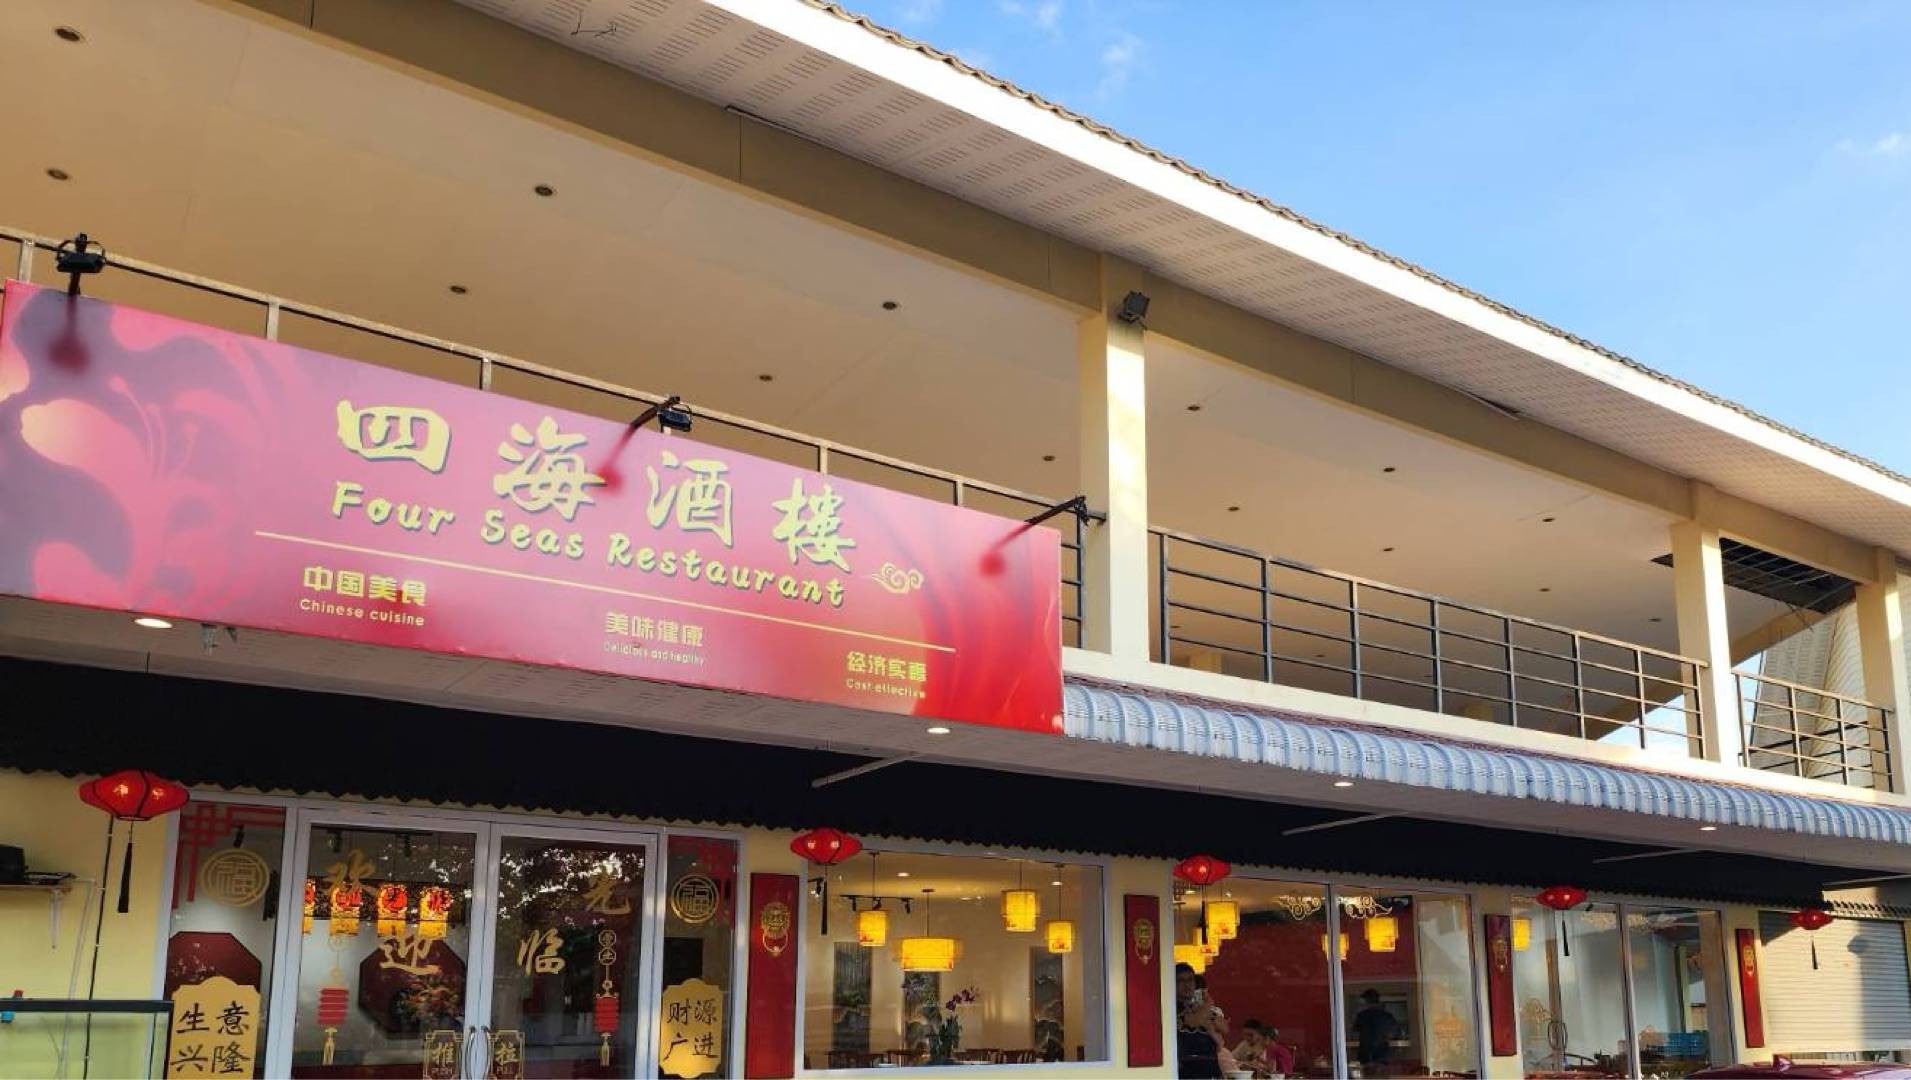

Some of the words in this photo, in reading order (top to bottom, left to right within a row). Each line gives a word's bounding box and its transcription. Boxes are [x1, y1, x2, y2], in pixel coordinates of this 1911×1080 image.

[332, 480, 455, 534] Four
[480, 509, 585, 560] Seas
[606, 532, 845, 608] Restaurant
[303, 566, 426, 607] 中国美食
[299, 598, 365, 620] Chinese
[368, 609, 426, 627] cuisine
[605, 611, 704, 648] 美味健康
[847, 650, 928, 683] 经济实惠
[176, 1000, 249, 1036] 生意
[666, 998, 717, 1026] 财源
[169, 1041, 251, 1074] 兴隆
[663, 1031, 719, 1061] 广进
